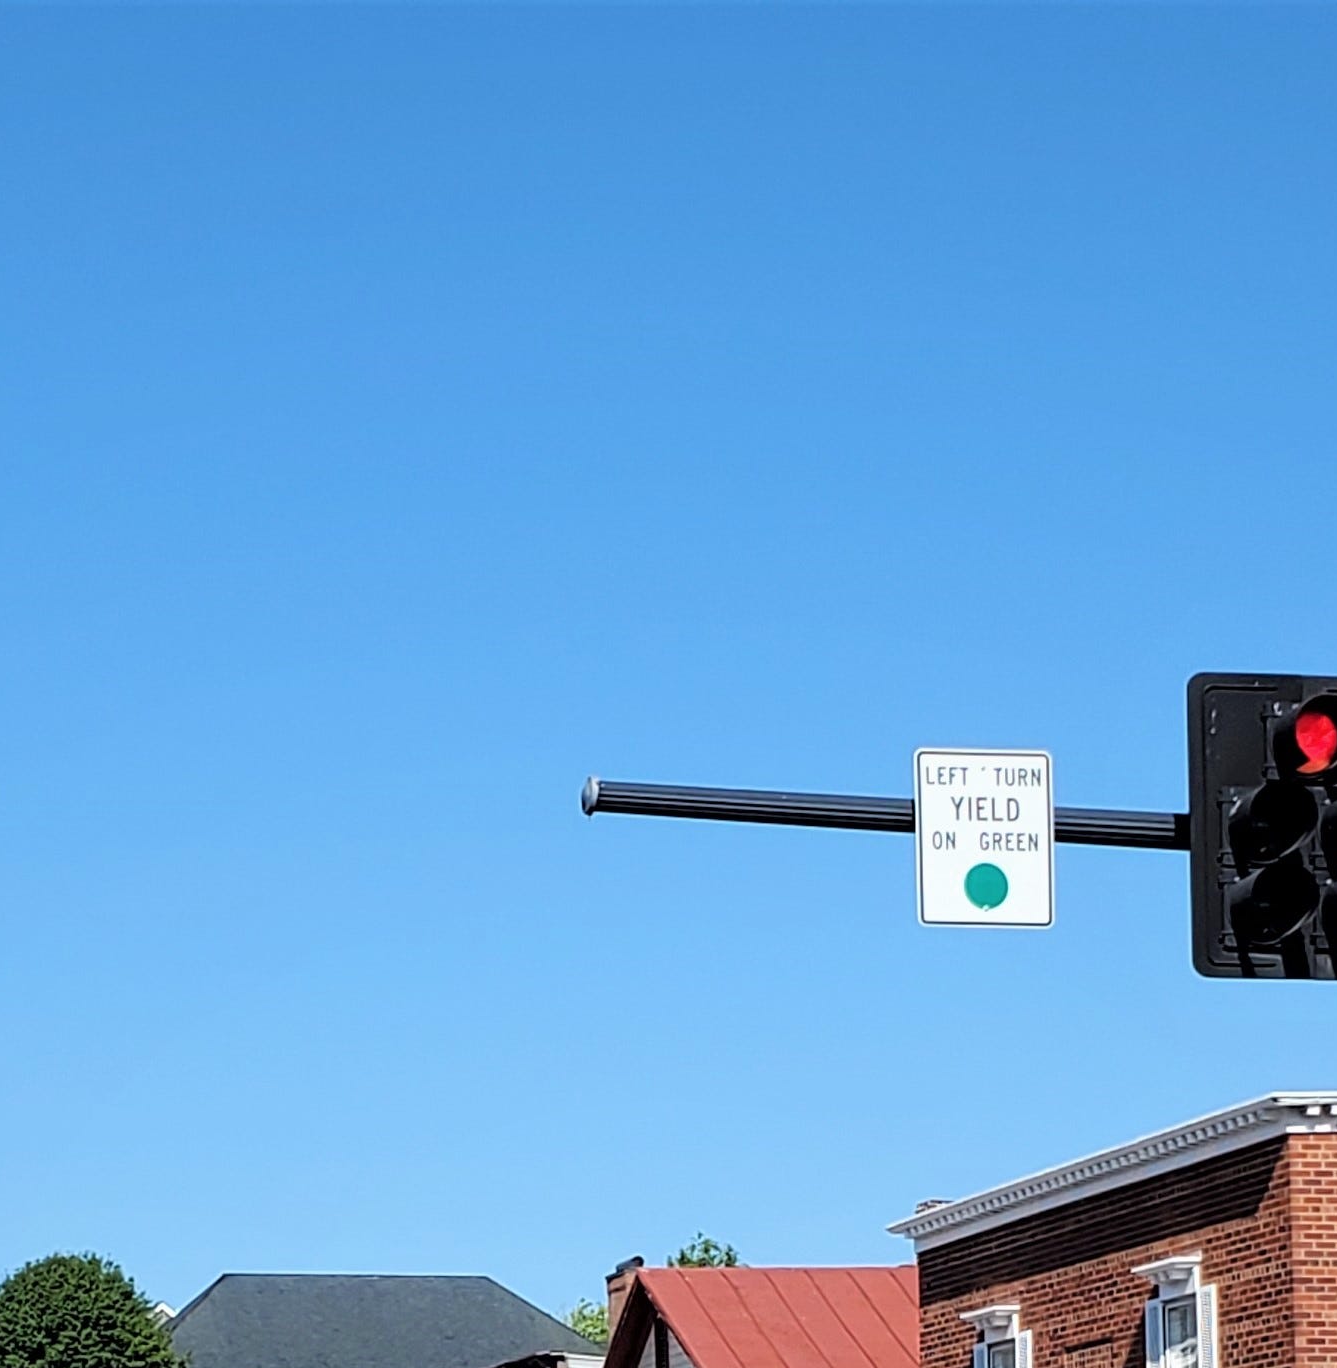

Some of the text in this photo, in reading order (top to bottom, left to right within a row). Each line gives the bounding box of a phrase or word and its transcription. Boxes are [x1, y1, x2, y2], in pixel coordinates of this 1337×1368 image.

[926, 765, 1042, 787] LEFT TURN
[950, 796, 1020, 822] YIELD
[932, 831, 1039, 852] ON GREEN
